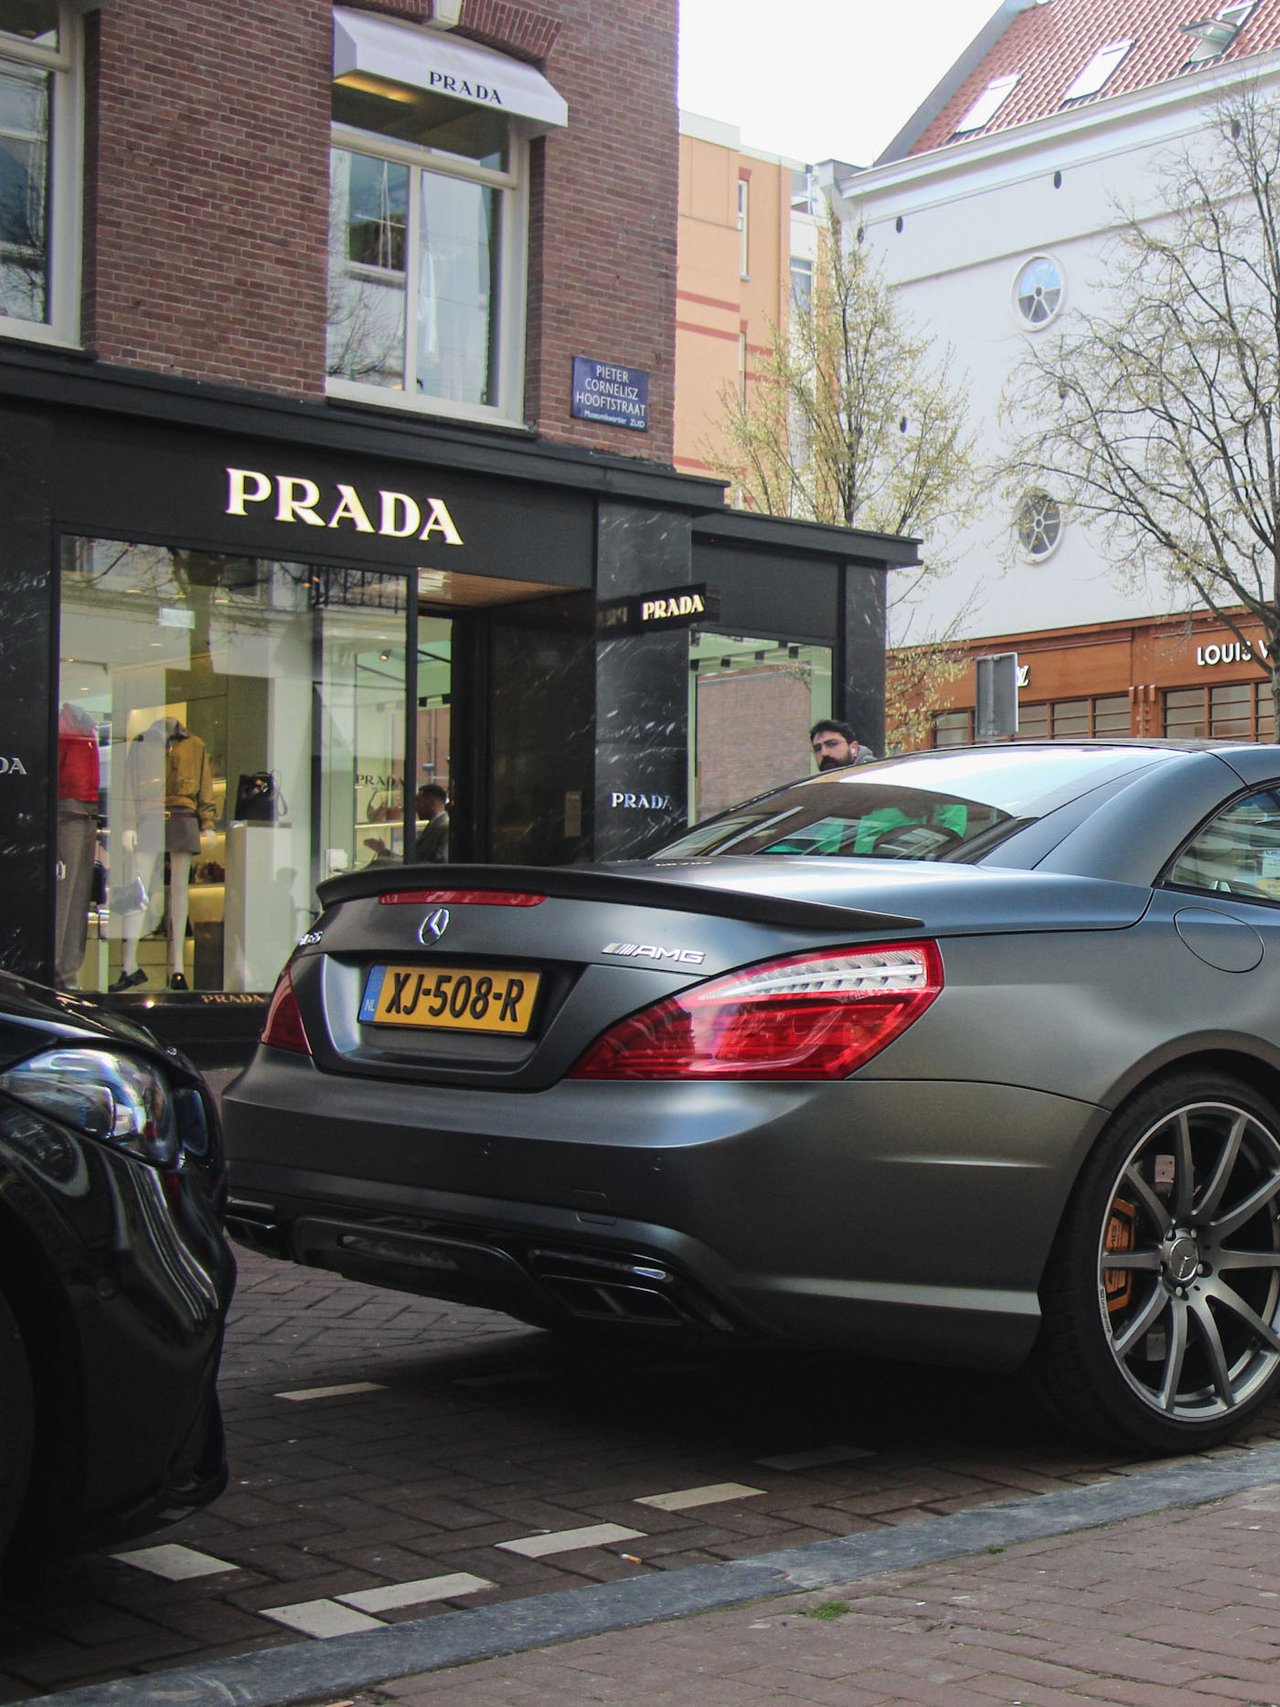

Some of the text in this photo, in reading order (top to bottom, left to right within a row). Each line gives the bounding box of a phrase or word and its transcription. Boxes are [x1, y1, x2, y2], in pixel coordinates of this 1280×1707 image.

[428, 70, 502, 105] PRADA
[596, 364, 629, 383] PIETER
[584, 377, 639, 400] CORNELISZ
[576, 390, 646, 417] HOOFTSTRAAT
[225, 468, 464, 545] PRADA
[642, 594, 705, 621] PRADA
[1197, 641, 1252, 666] LOUIS
[611, 792, 672, 811] PRADA
[631, 944, 706, 965] AMG
[201, 994, 266, 1004] PRADA
[364, 999, 376, 1011] NL
[385, 972, 524, 1022] XJ-508-R
